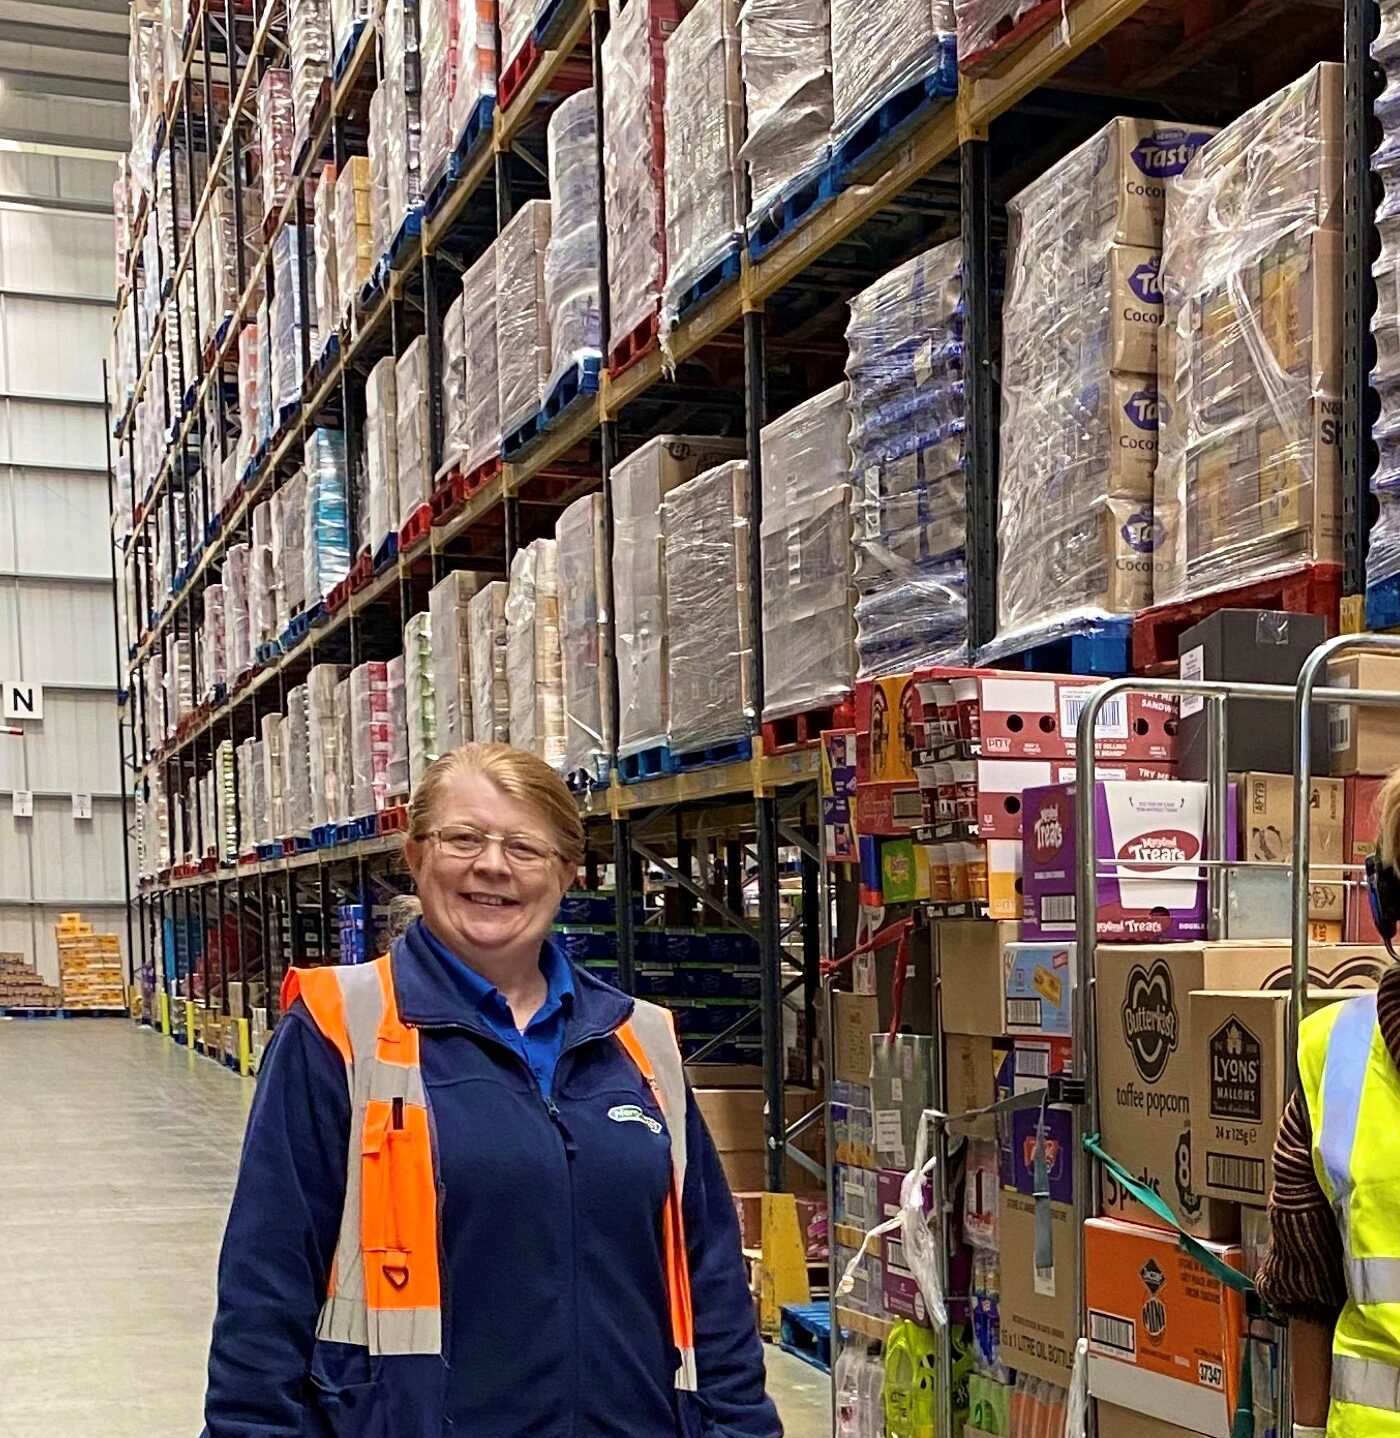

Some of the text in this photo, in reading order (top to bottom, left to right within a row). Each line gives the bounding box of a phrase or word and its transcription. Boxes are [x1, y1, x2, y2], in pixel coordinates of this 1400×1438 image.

[13, 688, 33, 711] N
[1128, 845, 1185, 861] Treats
[1116, 1082, 1144, 1109] toffee
